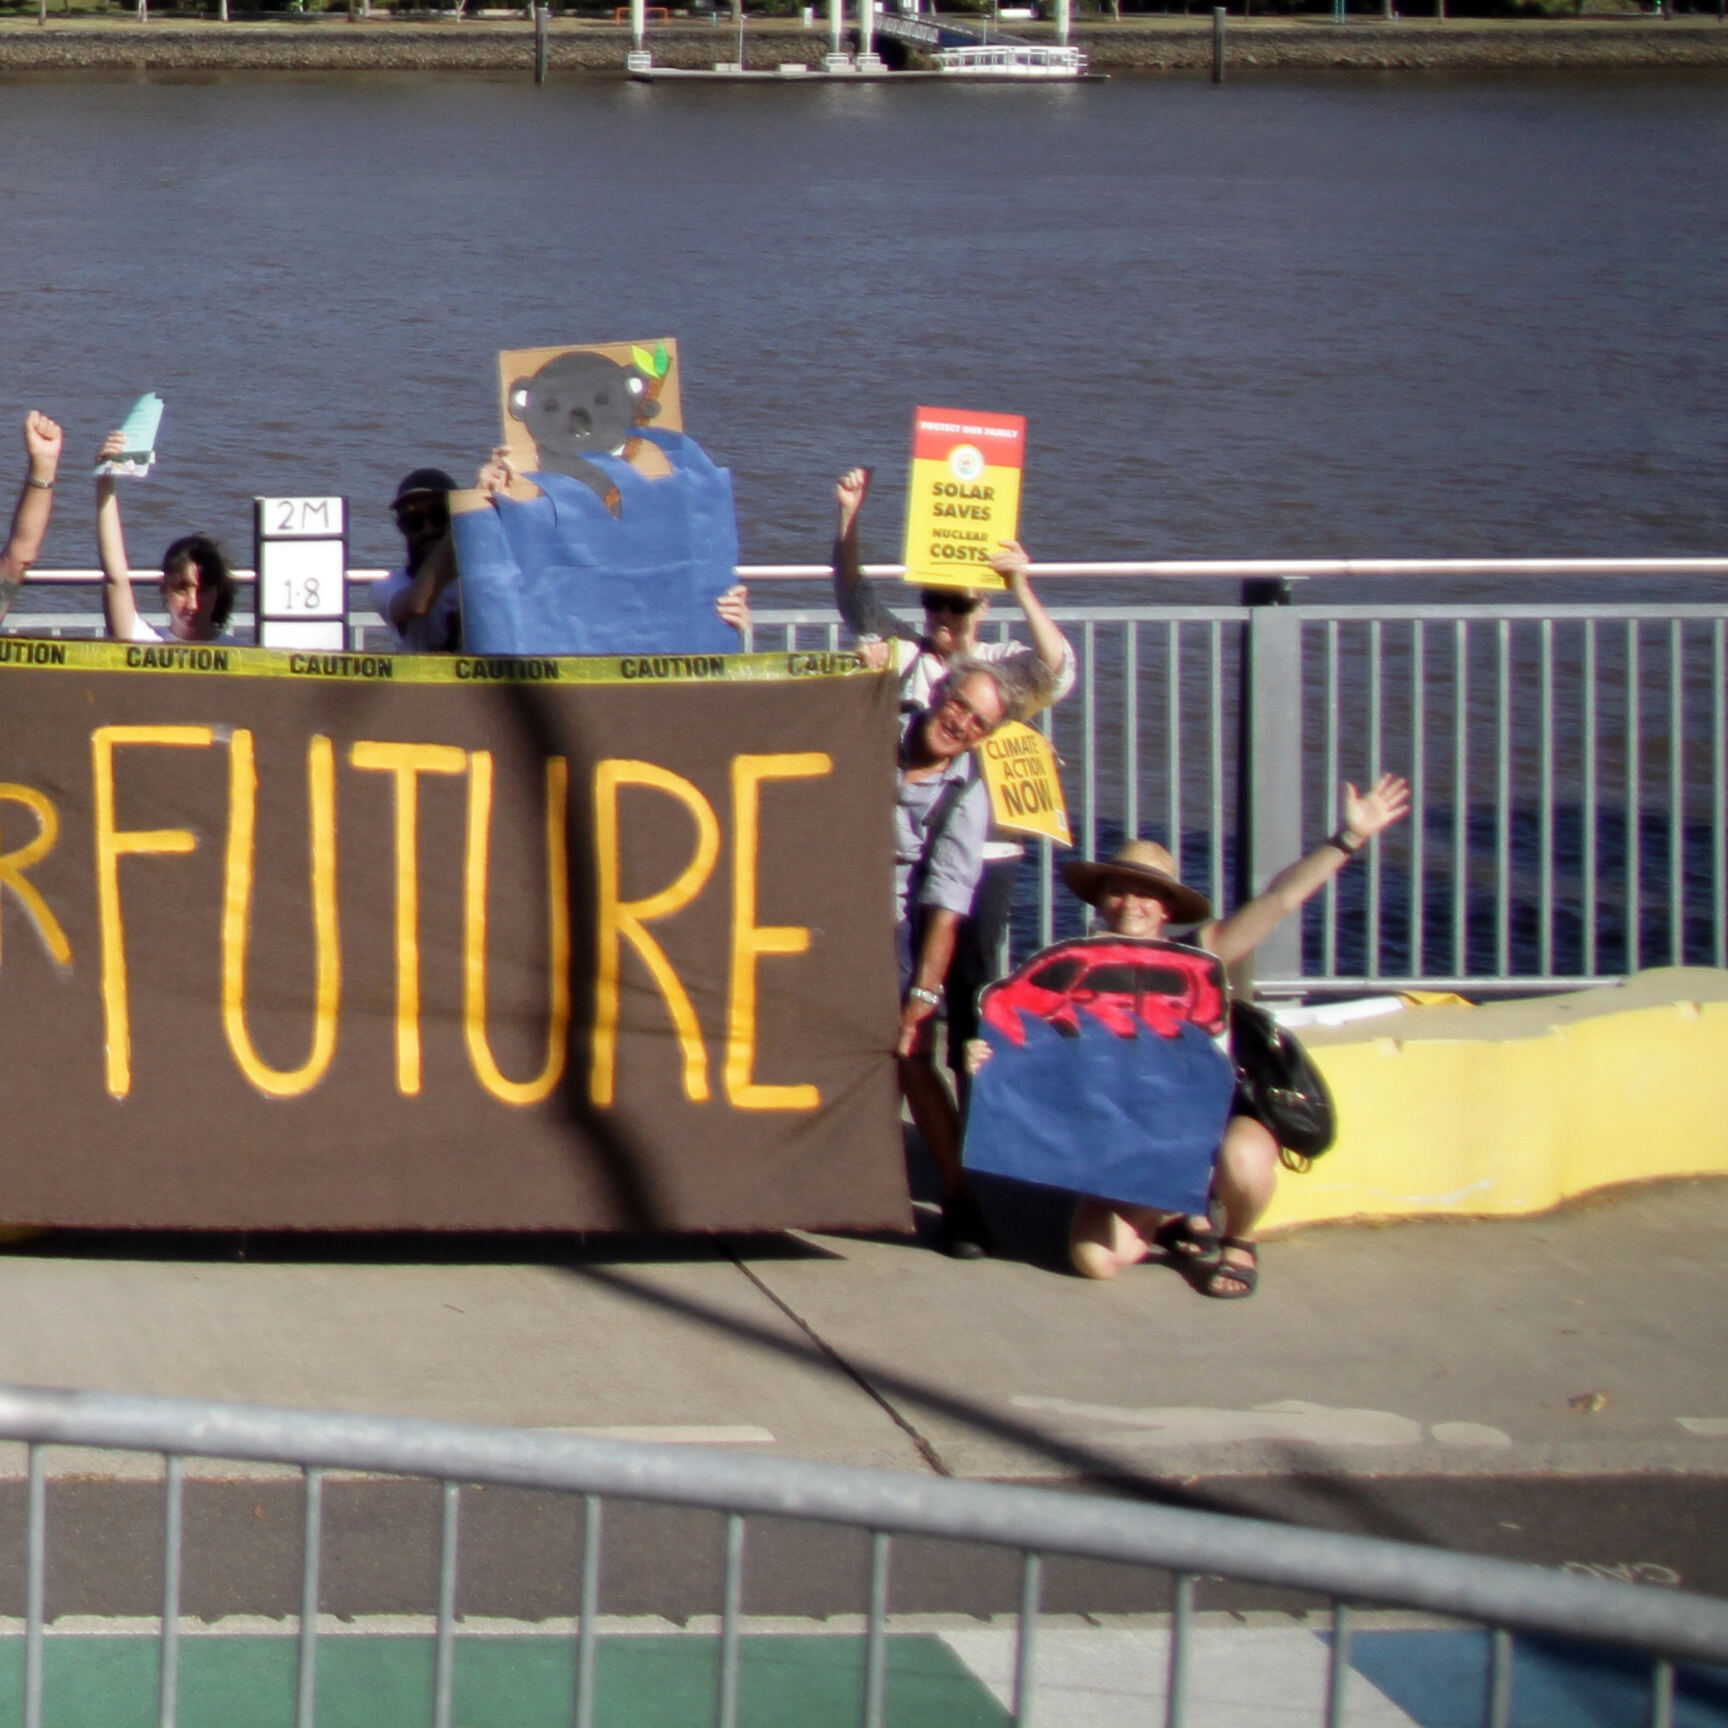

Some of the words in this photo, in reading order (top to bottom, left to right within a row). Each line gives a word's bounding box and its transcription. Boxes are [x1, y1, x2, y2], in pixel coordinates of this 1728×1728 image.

[933, 481, 995, 501] SOLAR
[933, 502, 991, 521] SAVES
[932, 528, 988, 542] NUCLEAR
[929, 544, 989, 562] COSTS
[126, 646, 228, 670] CAUTION
[289, 654, 393, 678] CAUTION
[454, 658, 559, 680] CAUTION
[621, 656, 725, 679] CAUTION
[986, 735, 1039, 760] CLIMATE
[1003, 756, 1047, 780] ACTION
[1000, 779, 1053, 817] NOW
[91, 724, 834, 1109] FUTURE
